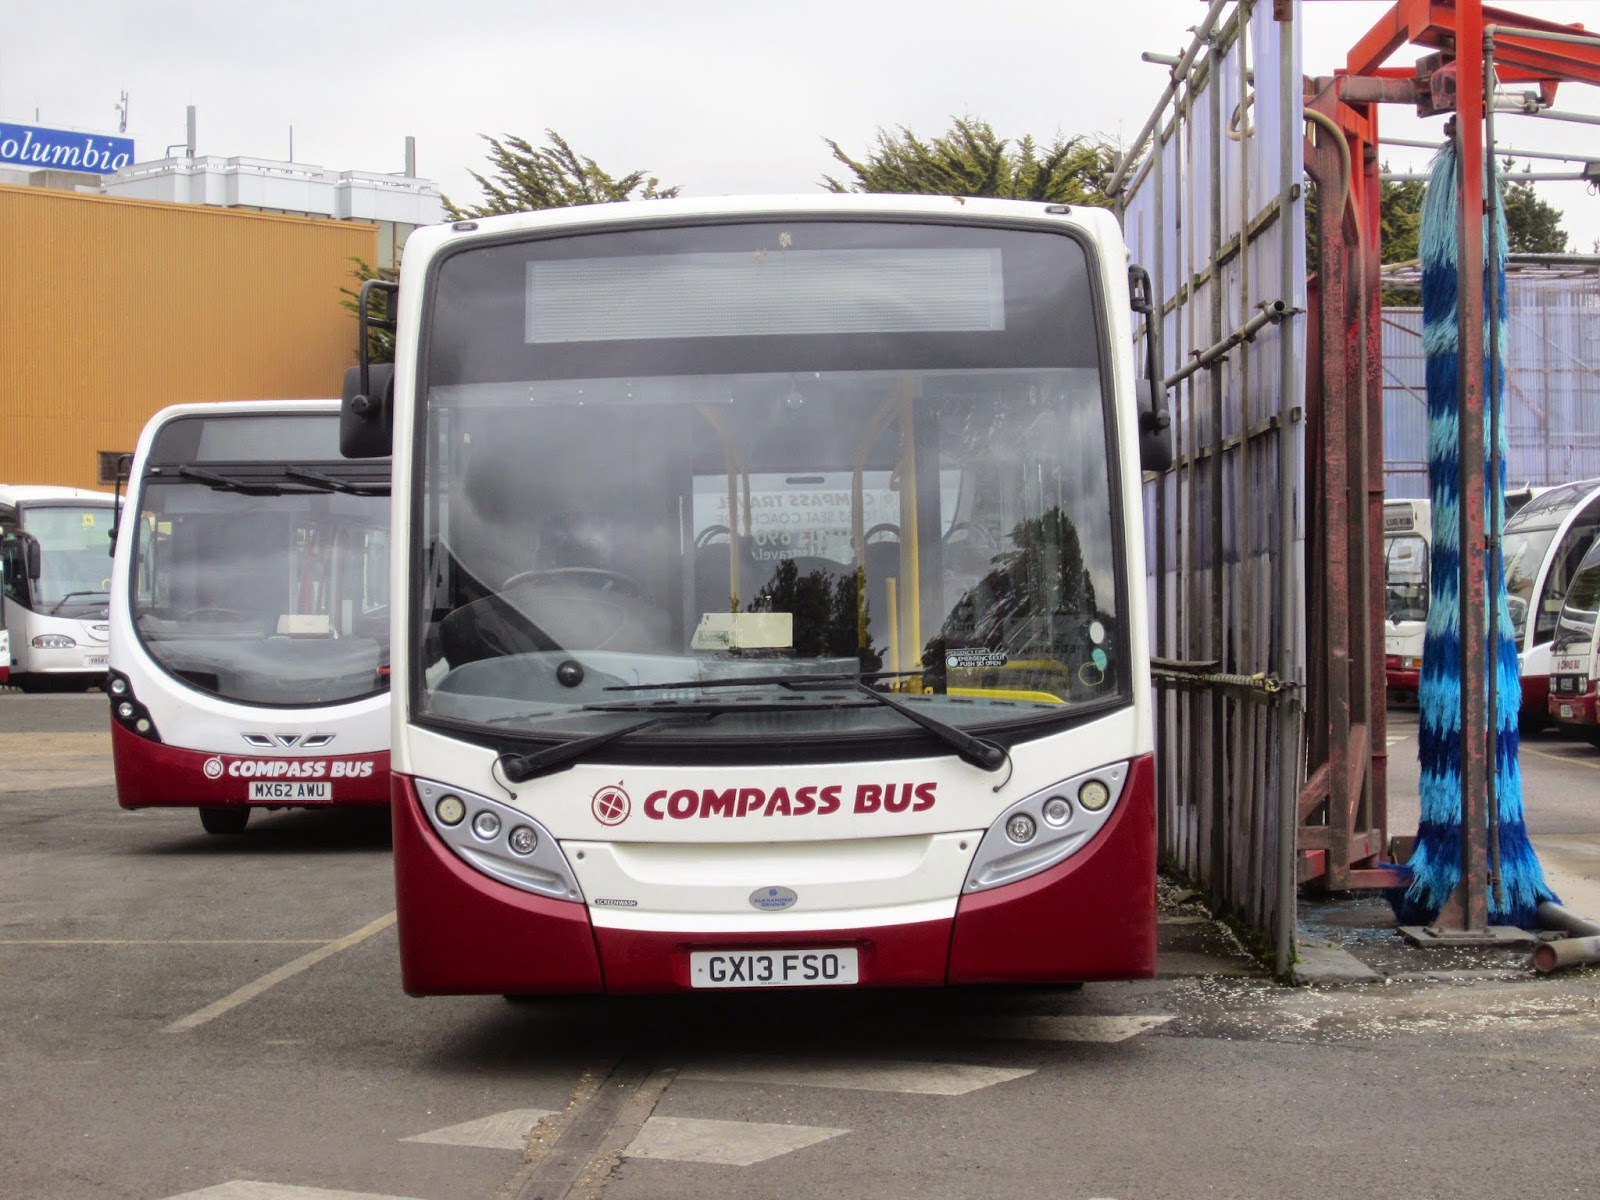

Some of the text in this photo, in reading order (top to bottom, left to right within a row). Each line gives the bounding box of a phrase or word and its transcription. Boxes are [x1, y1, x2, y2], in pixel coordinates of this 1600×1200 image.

[0, 131, 129, 171] olumbia
[228, 761, 374, 778] COMPASS BUS
[255, 783, 325, 798] MX62 AWU
[643, 782, 937, 820] COMPASS BUS
[709, 954, 839, 982] GX13 FSO
